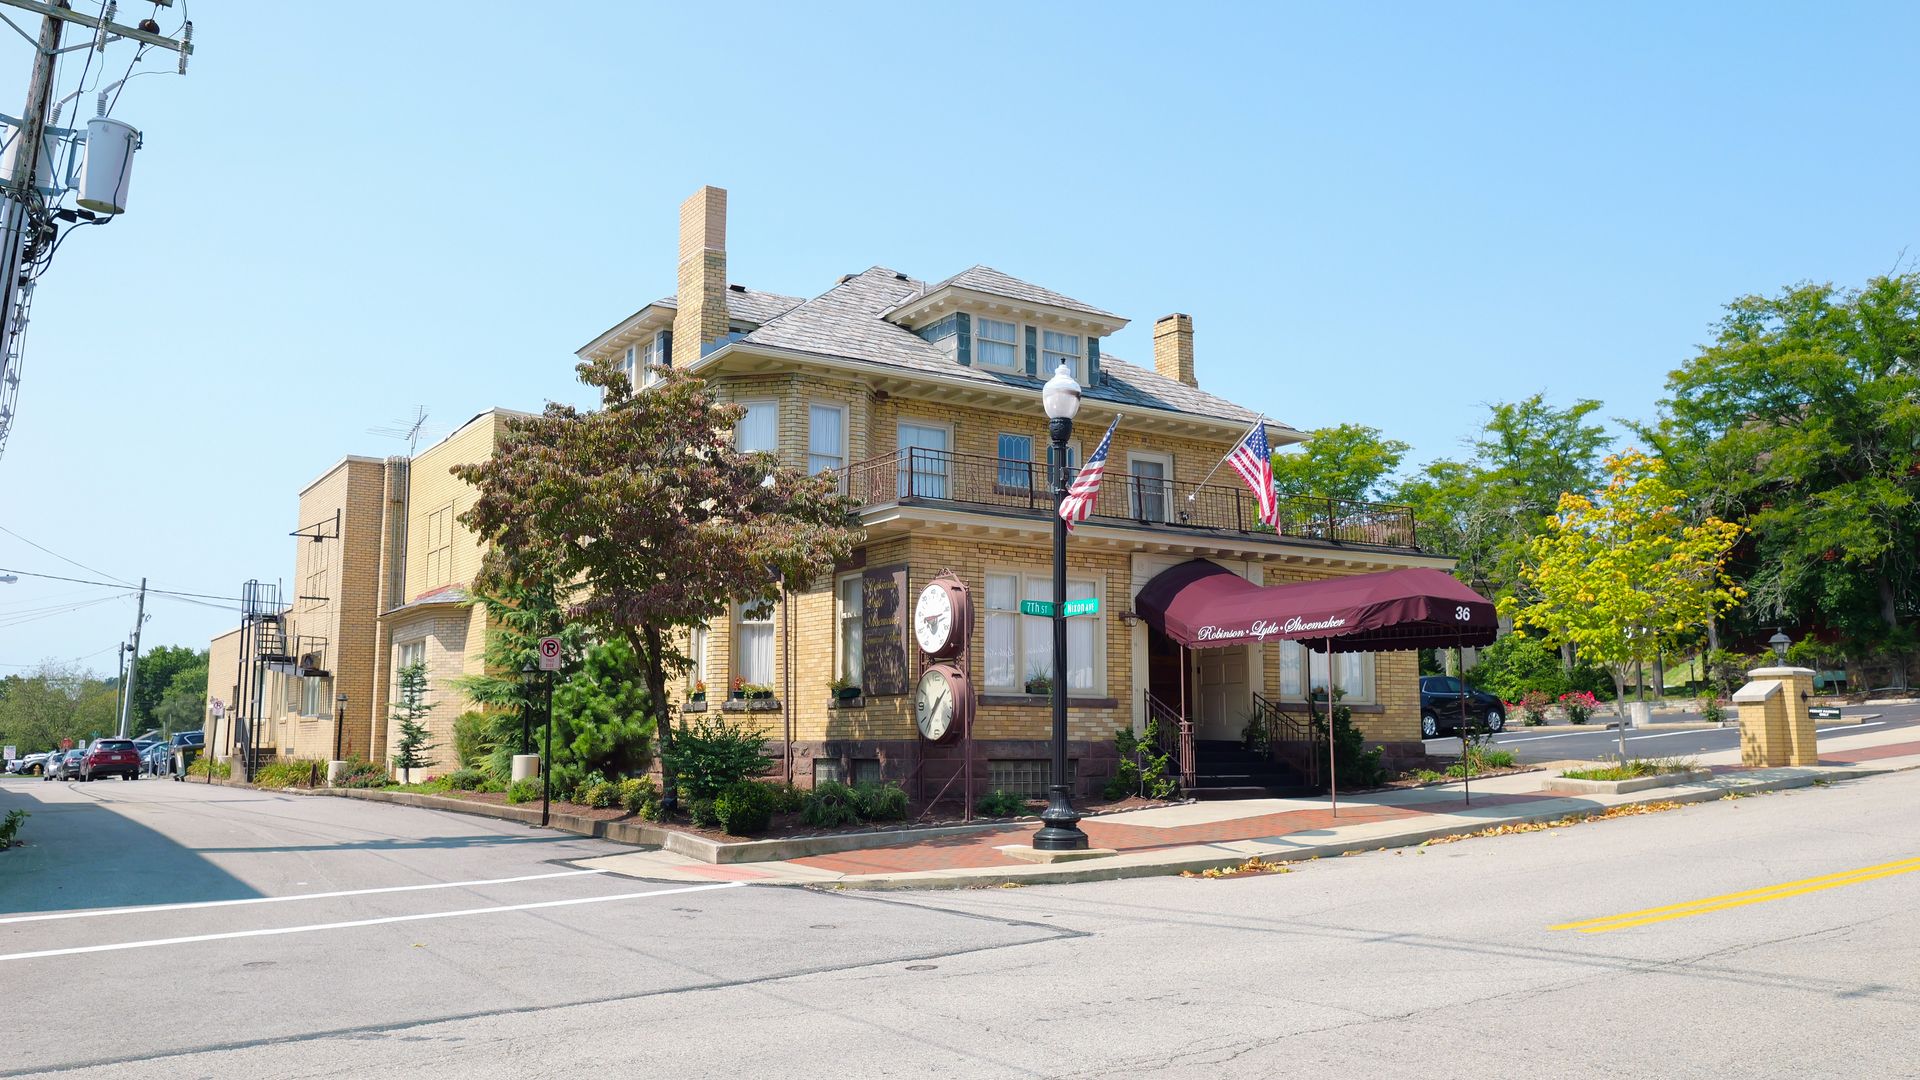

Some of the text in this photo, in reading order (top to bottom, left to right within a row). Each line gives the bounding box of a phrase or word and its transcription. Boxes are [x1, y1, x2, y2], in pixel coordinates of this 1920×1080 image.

[1067, 602, 1084, 614] Nixon
[1455, 606, 1470, 621] 36
[1198, 615, 1345, 641] Robinson Lytle Shoemaker
